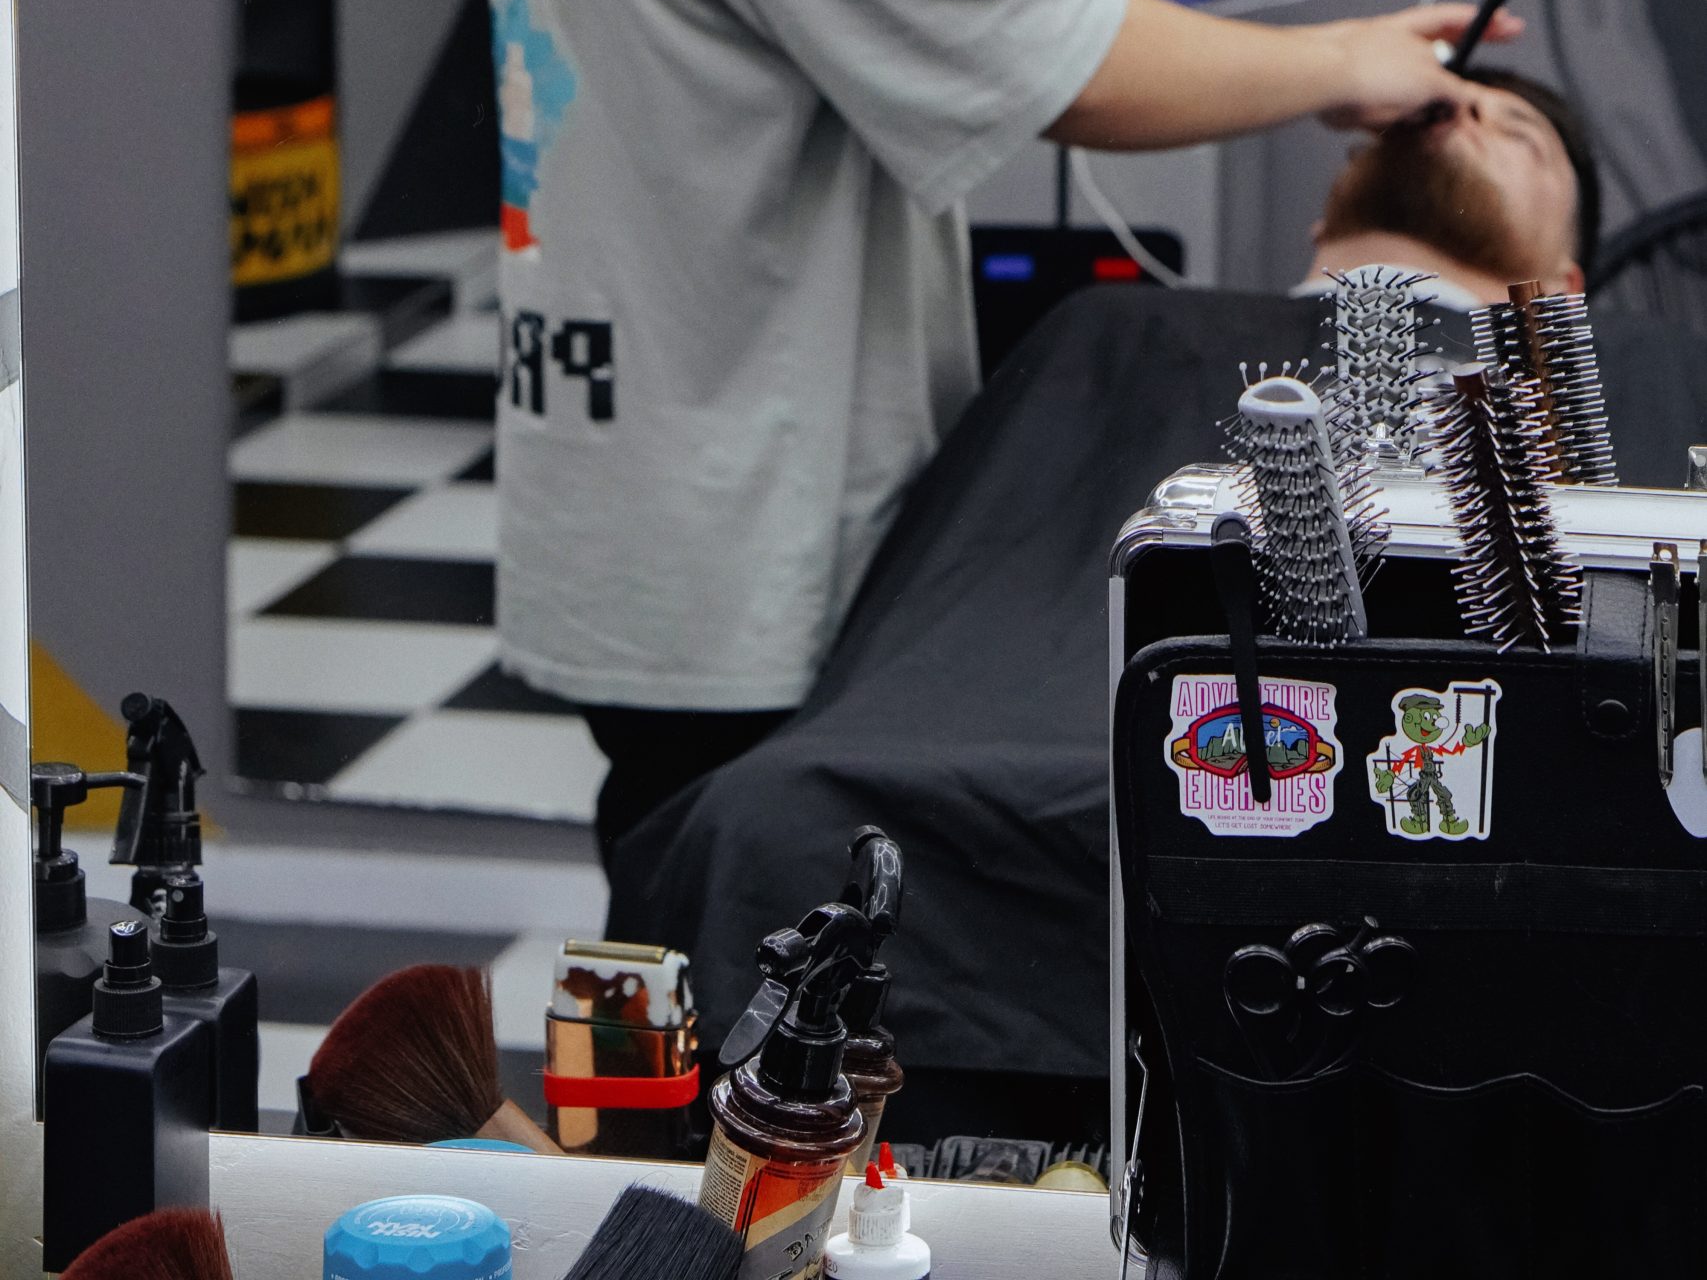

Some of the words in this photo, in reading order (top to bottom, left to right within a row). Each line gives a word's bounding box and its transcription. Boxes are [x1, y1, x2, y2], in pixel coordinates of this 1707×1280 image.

[1177, 681, 1331, 721] ADVTURE
[1185, 769, 1326, 814] EIGHIES
[1260, 823, 1292, 831] SOMEWHERE
